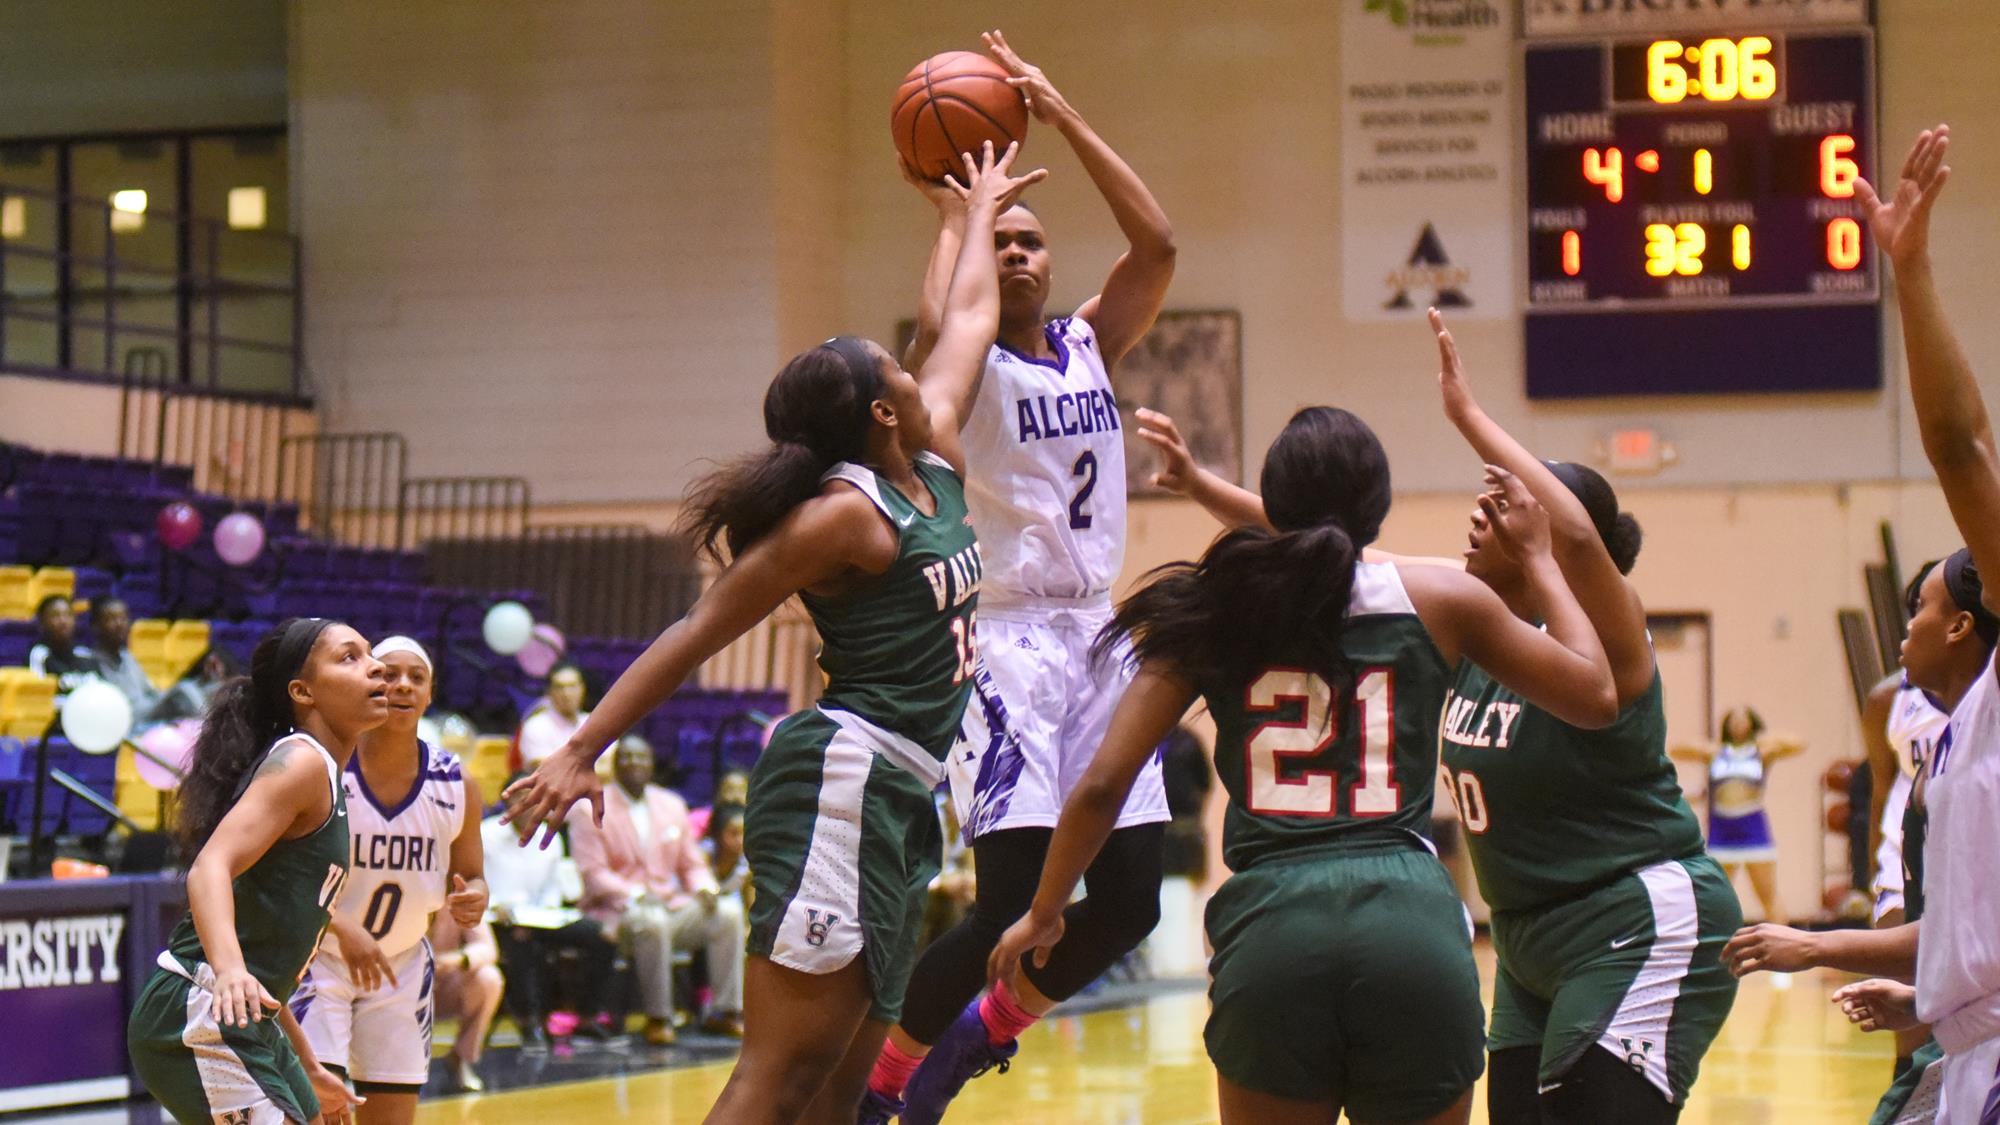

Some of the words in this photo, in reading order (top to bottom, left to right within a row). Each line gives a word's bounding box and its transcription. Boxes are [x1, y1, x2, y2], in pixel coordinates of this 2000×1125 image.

[1647, 37, 1776, 103] 6:06
[1542, 113, 1613, 141] HOME
[1773, 103, 1855, 133] GUEST
[1583, 147, 1623, 203] 4
[1694, 149, 1712, 195] 1
[1820, 135, 1859, 199] 6
[1562, 230, 1581, 276] 1
[1645, 222, 1706, 277] 32
[1732, 223, 1751, 271] 1
[1827, 217, 1861, 270] 0
[1016, 388, 1119, 443] ALCORN
[1069, 449, 1098, 530] 2
[1245, 667, 1402, 817] 21
[353, 833, 439, 873] LCOR
[362, 882, 403, 942] 0
[0, 915, 125, 989] RSITY
